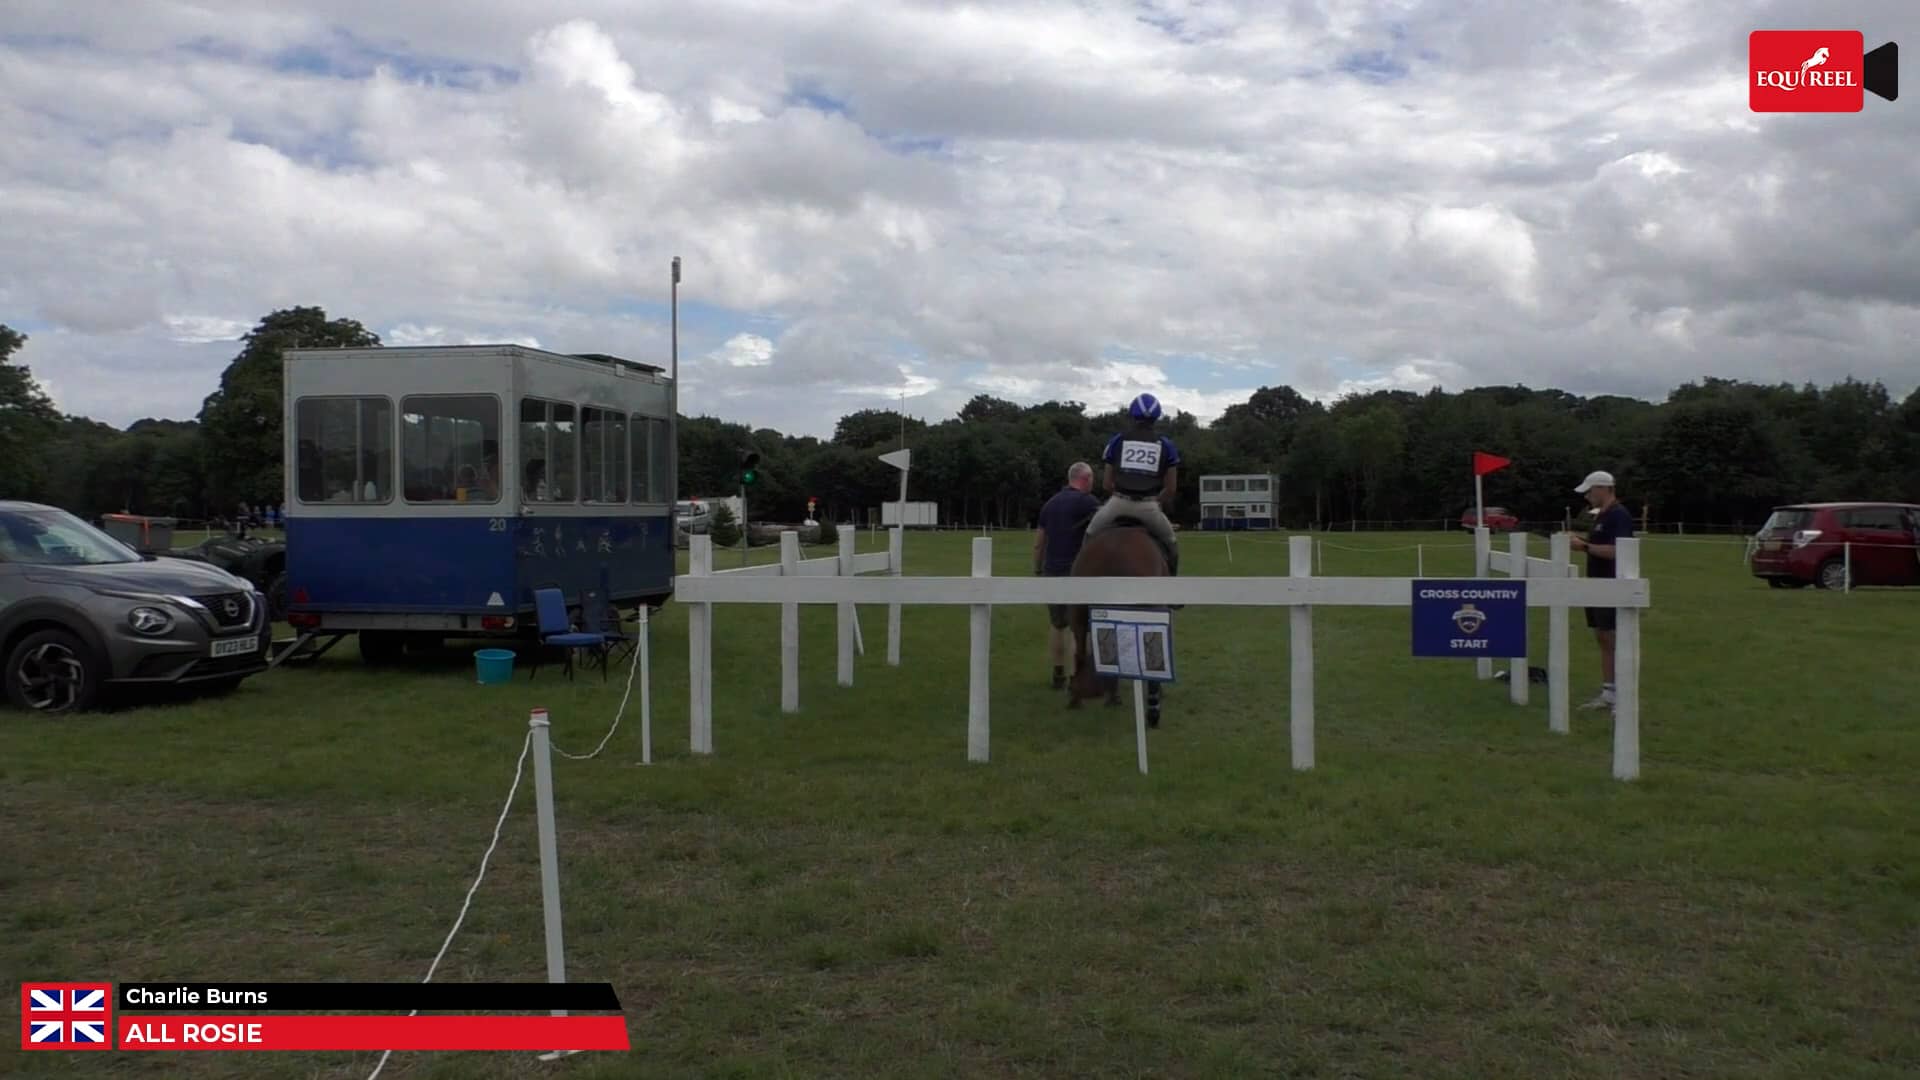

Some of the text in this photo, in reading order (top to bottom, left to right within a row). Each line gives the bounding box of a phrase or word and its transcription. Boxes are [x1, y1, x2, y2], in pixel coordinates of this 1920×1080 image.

[1124, 449, 1157, 465] 225
[489, 519, 506, 531] 20
[1420, 590, 1518, 599] CROSS COUNTRY
[1450, 639, 1488, 649] START
